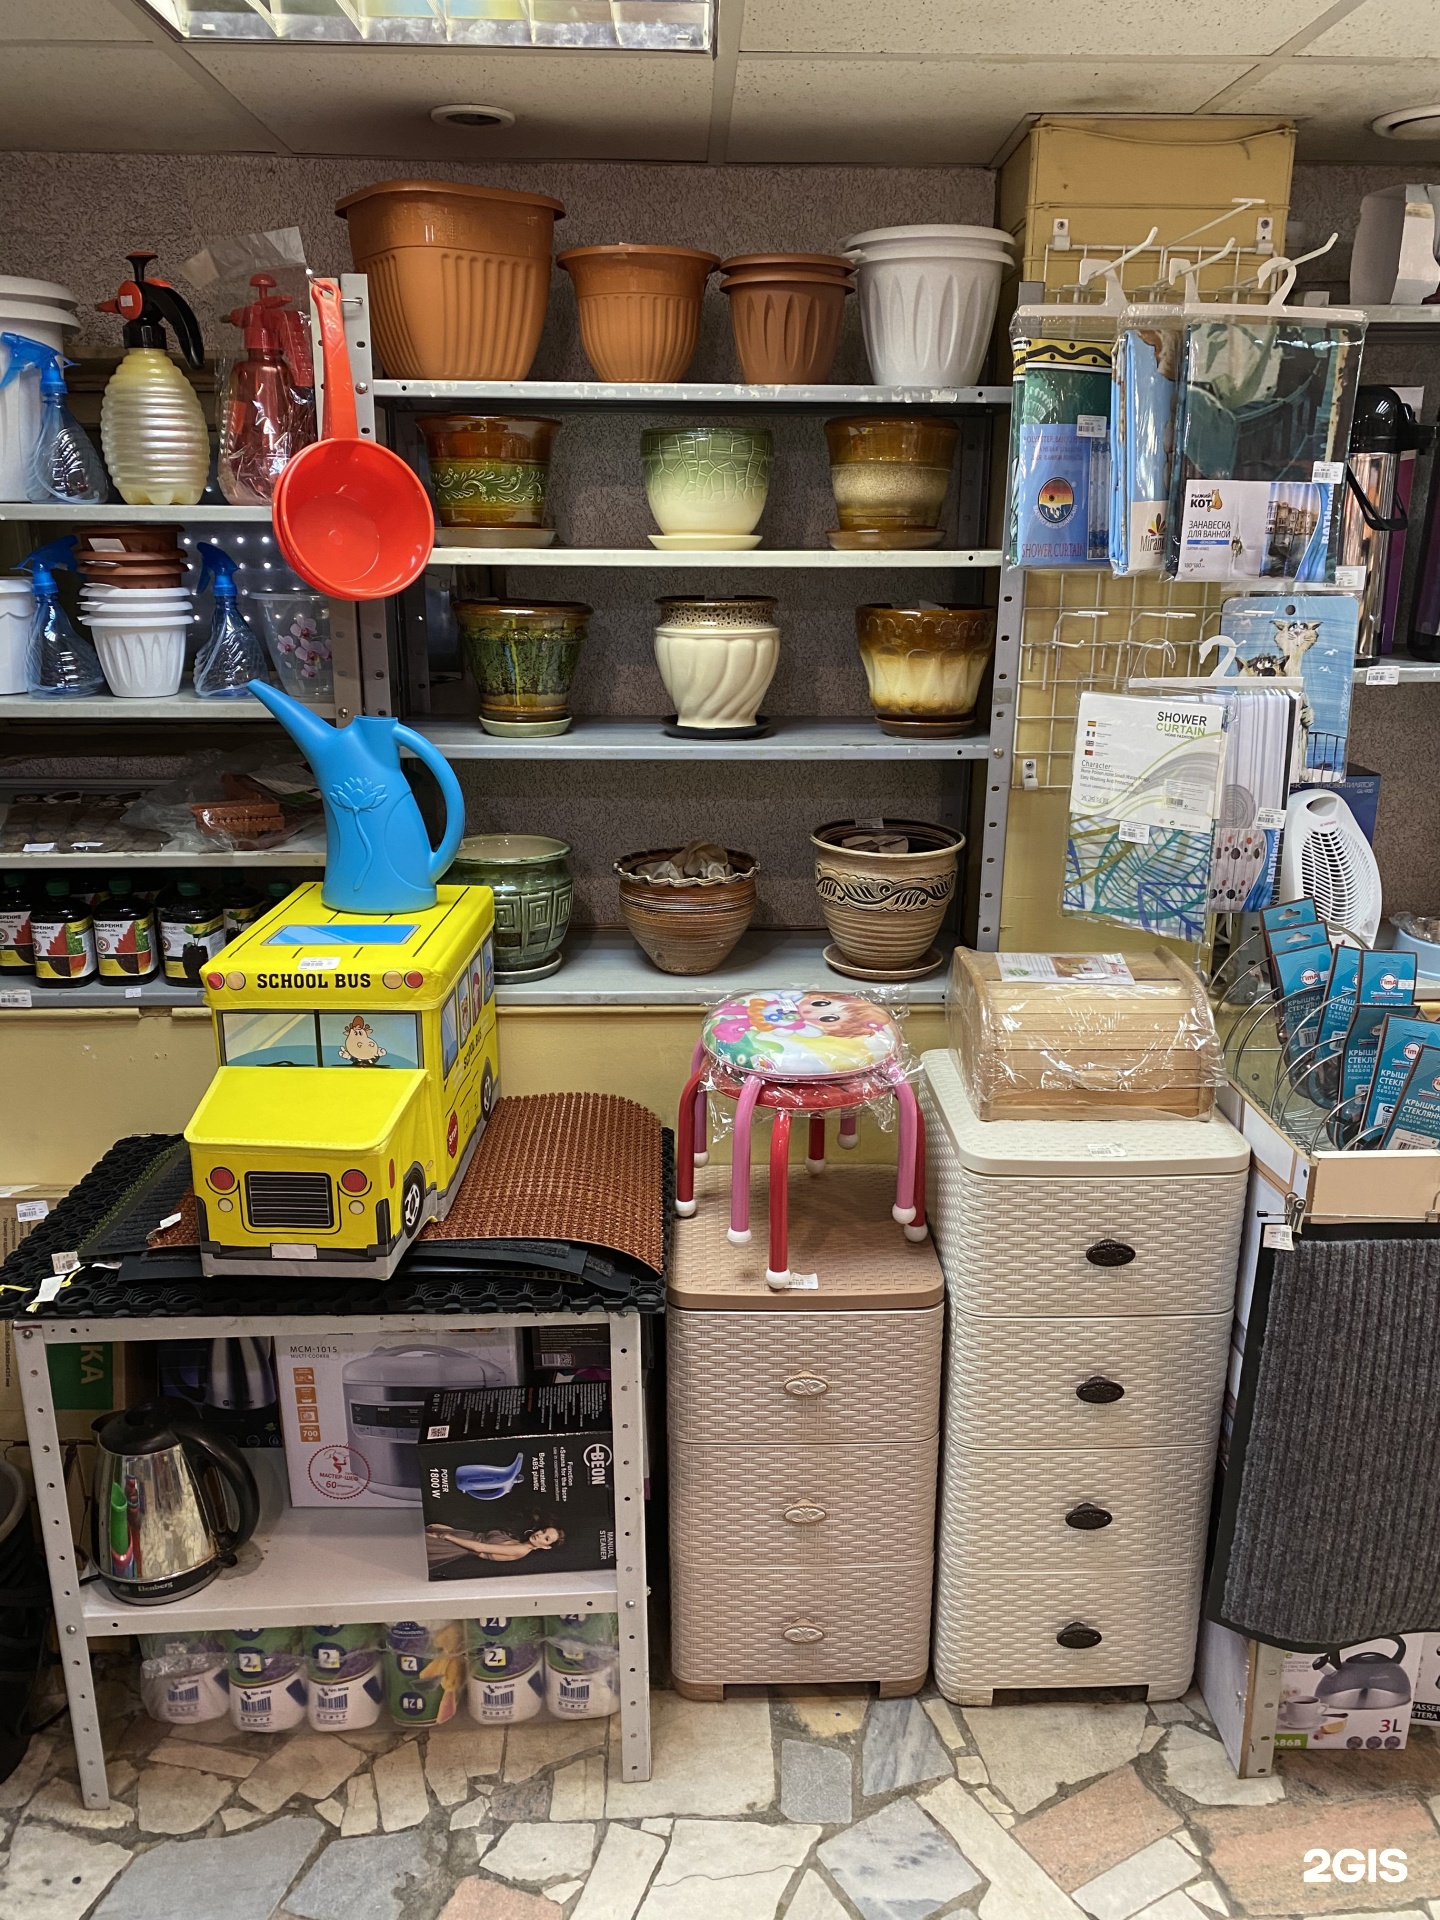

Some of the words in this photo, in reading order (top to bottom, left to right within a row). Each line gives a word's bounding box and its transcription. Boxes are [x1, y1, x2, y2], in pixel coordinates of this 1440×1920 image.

[1190, 499, 1213, 508] КОТ
[1188, 520, 1232, 530] ЗАНАВЕСКА
[1187, 530, 1203, 539] ДЛЯ
[1203, 529, 1231, 538] ВАННОЙ
[1021, 543, 1053, 558] SHOWER
[1053, 542, 1086, 557] CURTAIN
[1157, 711, 1207, 726] SHOWER
[1156, 723, 1206, 736] CURTAIN
[257, 973, 329, 989] SCHOOL
[334, 973, 372, 989] BUS
[1330, 1003, 1356, 1012] СТЕКЛ
[1381, 1069, 1408, 1079] КРЫШ
[591, 1451, 606, 1485] BEON
[430, 1468, 439, 1488] 1800
[440, 1469, 449, 1493] POWER
[431, 1489, 441, 1499] W
[599, 1530, 607, 1560] STEAMER
[607, 1531, 615, 1558] MANUAL
